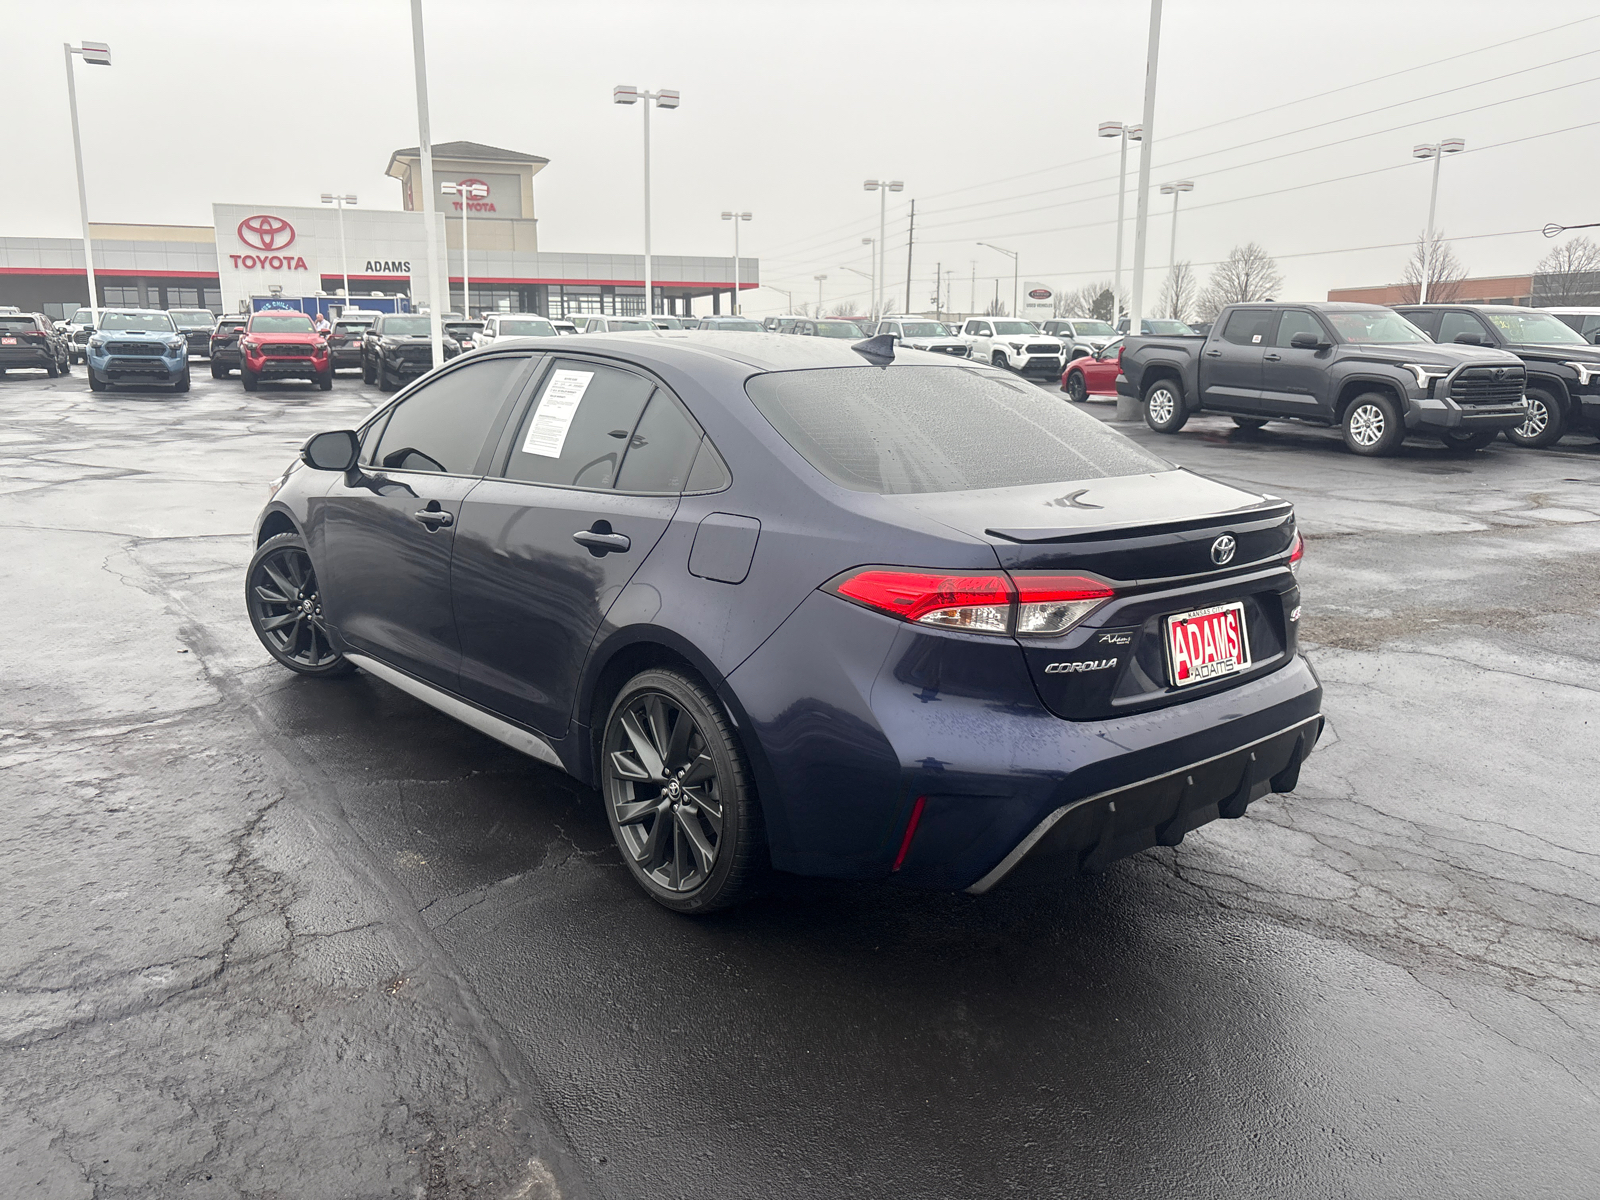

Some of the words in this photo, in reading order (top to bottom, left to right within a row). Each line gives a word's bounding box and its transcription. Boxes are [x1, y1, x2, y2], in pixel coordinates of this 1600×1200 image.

[229, 254, 308, 270] TOYOTA
[365, 260, 411, 273] ADAMS
[1187, 608, 1211, 618] KANSAS
[1212, 606, 1224, 614] CITY
[1174, 613, 1238, 672] ADAMS
[1044, 657, 1118, 674] COROLLA
[1193, 658, 1235, 680] ADAMS
